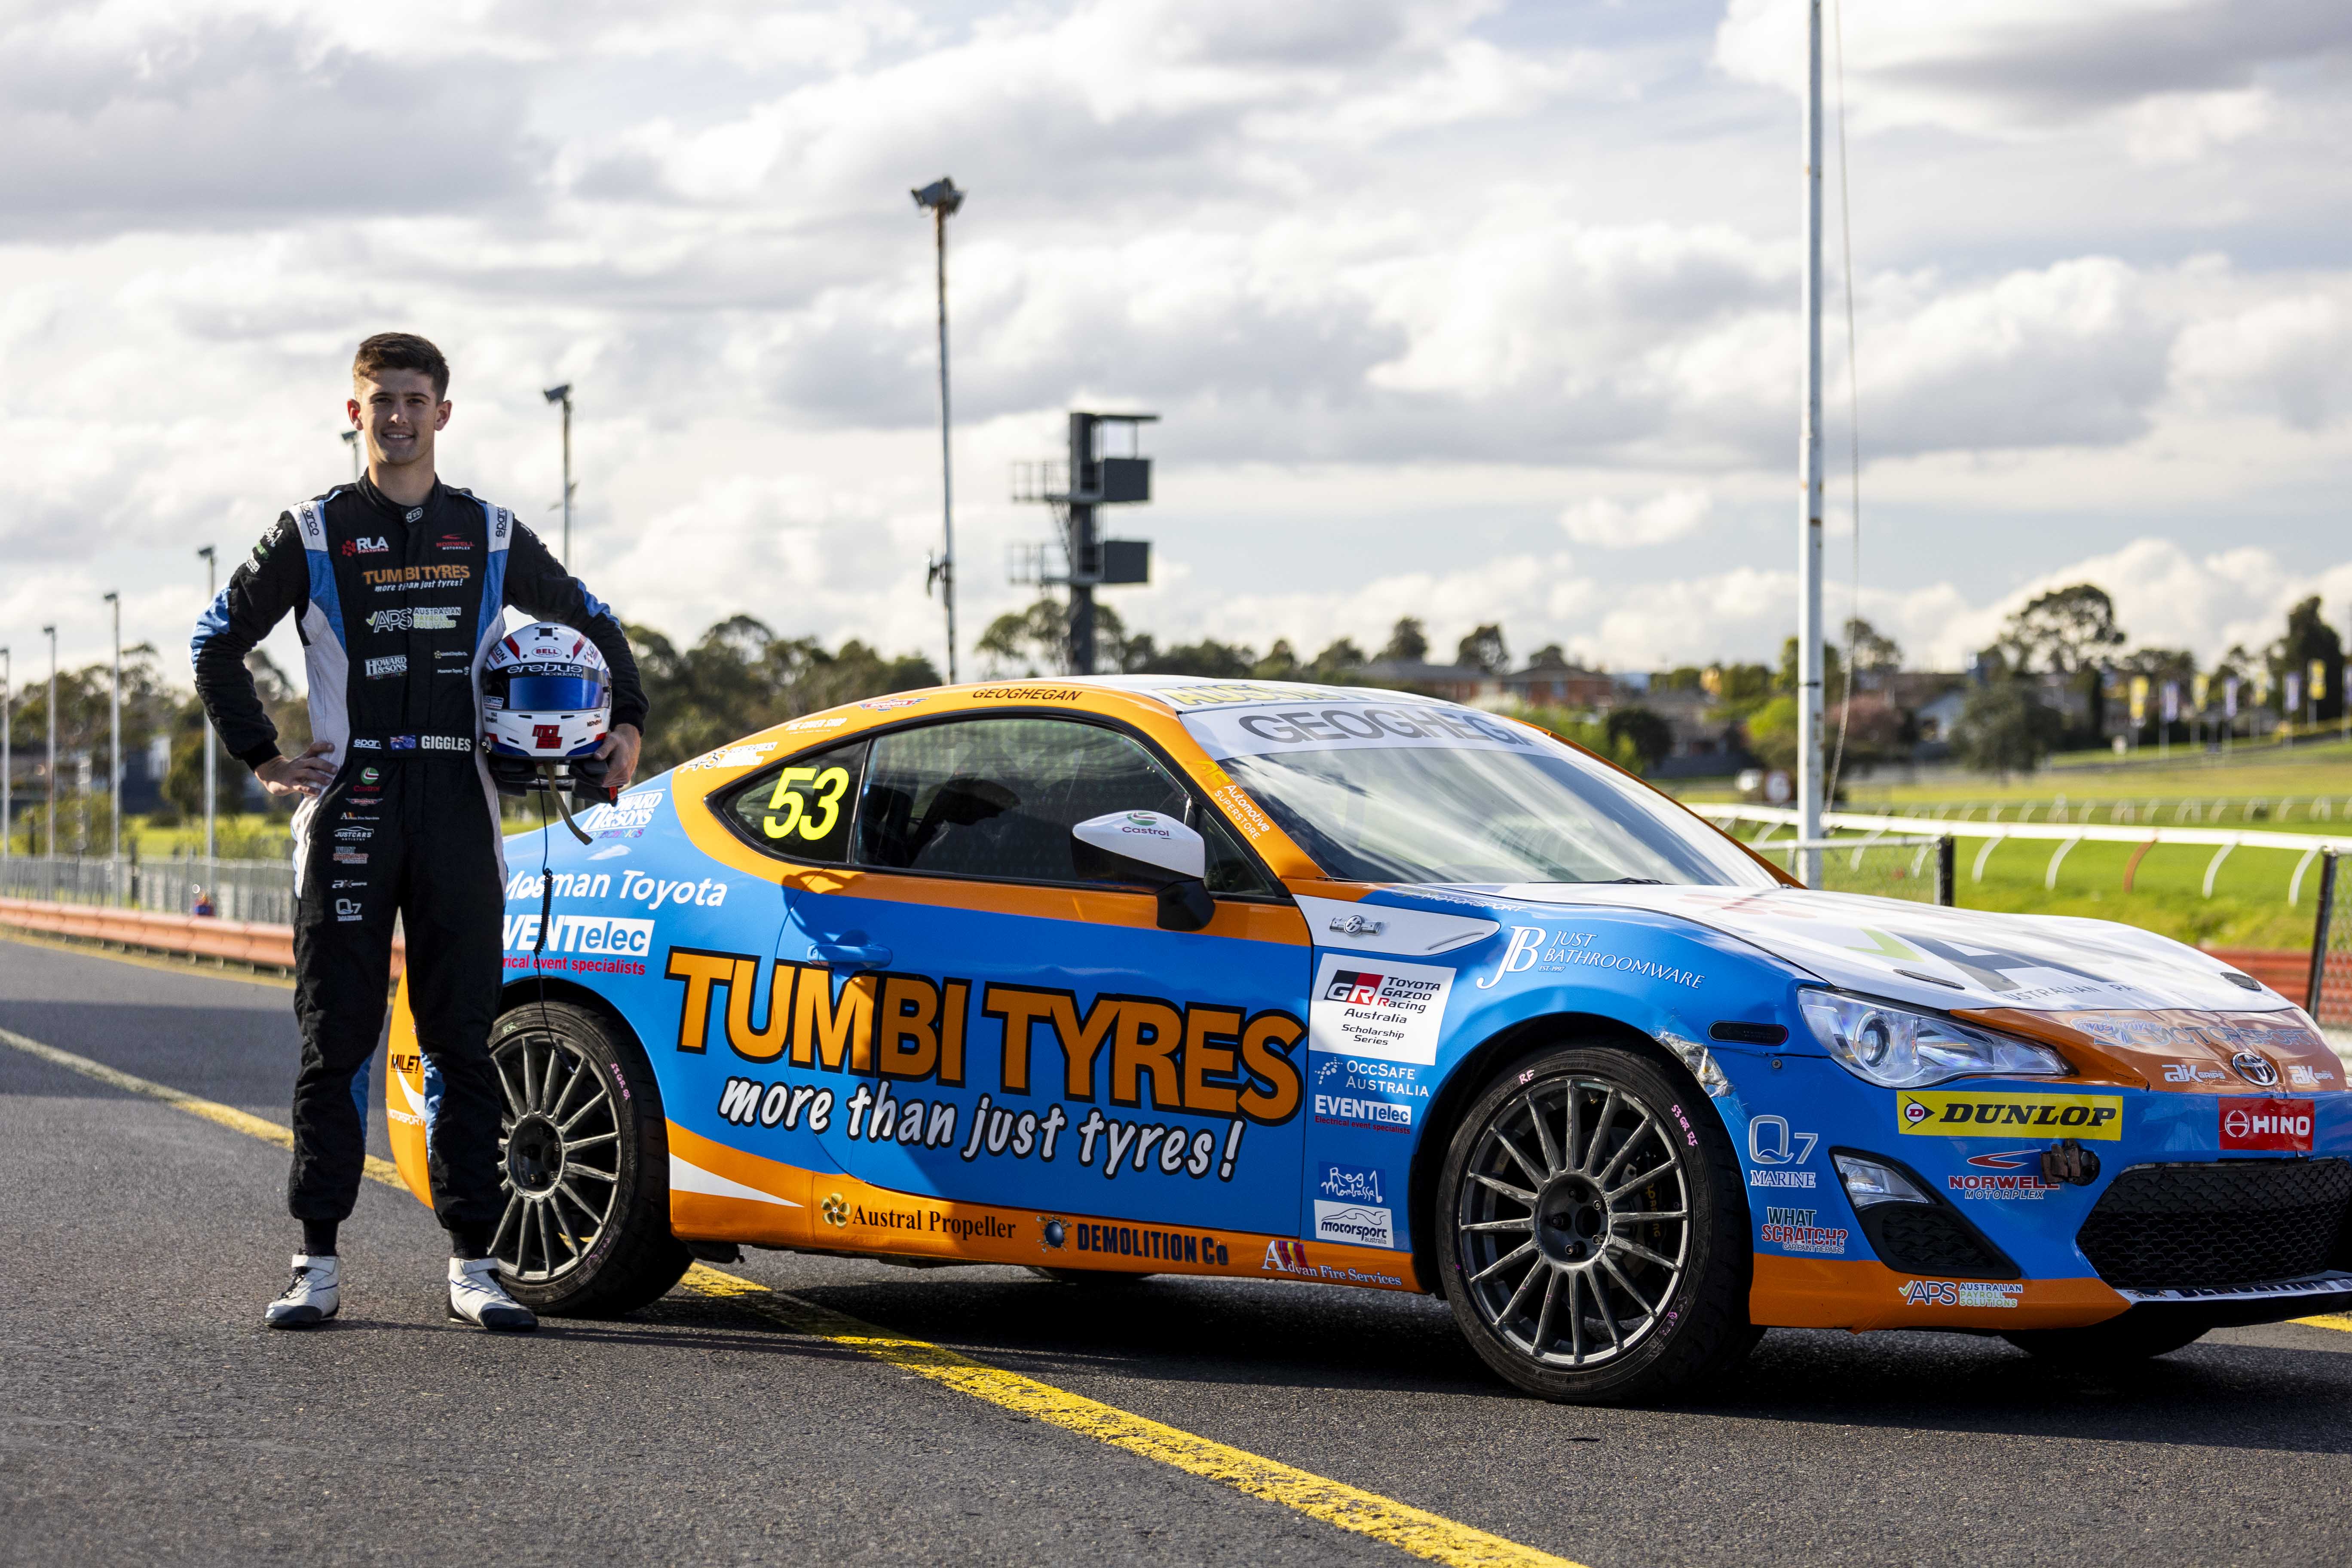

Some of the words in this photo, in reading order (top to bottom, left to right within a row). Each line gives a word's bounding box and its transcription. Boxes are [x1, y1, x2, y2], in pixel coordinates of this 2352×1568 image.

[300, 503, 319, 536] parco
[496, 506, 506, 537] sparc
[356, 536, 389, 551] RLA
[363, 566, 420, 585] TUMBI
[421, 564, 471, 579] TYRES
[374, 584, 395, 592] more
[398, 580, 419, 591] than
[420, 580, 436, 589] just
[438, 578, 463, 588] tyres!
[373, 608, 413, 633] APS
[413, 607, 461, 616] AUSTRALIAN
[413, 620, 456, 629] SOLUTIONS
[365, 656, 407, 675] HOWARD
[507, 662, 583, 674] erebus
[972, 688, 1083, 701] GEOGHEGAN
[1238, 710, 1534, 747] GEOGHEG
[354, 738, 381, 747] spar
[421, 735, 471, 751] GIGGLES
[763, 767, 850, 840] 53
[1223, 784, 1271, 833] Automotive
[1214, 789, 1262, 841] SUPERSTORE
[1122, 826, 1170, 837] Castrol
[619, 870, 728, 910] Toyota
[336, 898, 362, 915] Q7
[1421, 892, 1528, 912] MOTORSPORT
[503, 915, 655, 957] VENTelec
[1550, 930, 1598, 949] JUST
[503, 956, 530, 969] rical
[533, 956, 567, 970] event
[571, 959, 646, 976] specialists
[1476, 925, 1547, 989] JB
[1543, 947, 1706, 990] BATHROOMWARE
[1387, 976, 1441, 991] TOYOTA
[1325, 983, 1377, 1005] GR
[1381, 988, 1432, 1001] GAZOO
[1377, 997, 1427, 1014] Racing
[1344, 1008, 1408, 1024] Australia
[664, 945, 973, 1089] TUMBI
[981, 980, 1308, 1127] TYRES
[1341, 1024, 1405, 1039] Scholarship
[1353, 1034, 1389, 1045] Series
[2153, 1026, 2318, 1046] MOTORSPORT
[1346, 1075, 1430, 1097] AUSTRALIA
[1519, 1069, 1535, 1084] RF
[1315, 1094, 1412, 1125] EVENTelec
[1908, 1108, 1923, 1118] D
[1939, 1103, 2117, 1127] DUNLOP
[718, 1076, 835, 1135] more
[846, 1078, 958, 1151] than
[960, 1092, 1068, 1163] just
[1078, 1106, 1247, 1183] tyres!
[1315, 1115, 1349, 1127] Electrical
[1351, 1120, 1371, 1130] event
[1372, 1122, 1411, 1135] specialists
[2252, 1116, 2310, 1136] HINO
[1749, 1114, 1819, 1165] Q7
[1329, 1167, 1364, 1186] Reg
[1750, 1170, 1816, 1188] MARINE
[1964, 1190, 2046, 1200] MOTORPLEX
[852, 1204, 922, 1231] Austral
[928, 1210, 1016, 1241] Propeller
[1767, 1207, 1817, 1226] WHAT
[1321, 1220, 1387, 1242] motorsport
[1364, 1236, 1387, 1245] australia
[1761, 1223, 1848, 1246] SCRATCH?
[1077, 1223, 1197, 1264] DEMOLITION
[1782, 1243, 1797, 1251] CAR
[1797, 1243, 1816, 1252] PAINT
[1816, 1245, 1844, 1254] REPAIRS
[1261, 1240, 1319, 1278] Advan
[1319, 1265, 1346, 1280] Fire
[1348, 1268, 1402, 1286] Services
[1907, 1280, 1957, 1306] APS
[1958, 1283, 2023, 1293] AUSTRALIAN
[1958, 1298, 2018, 1308] SOLUTIONS
